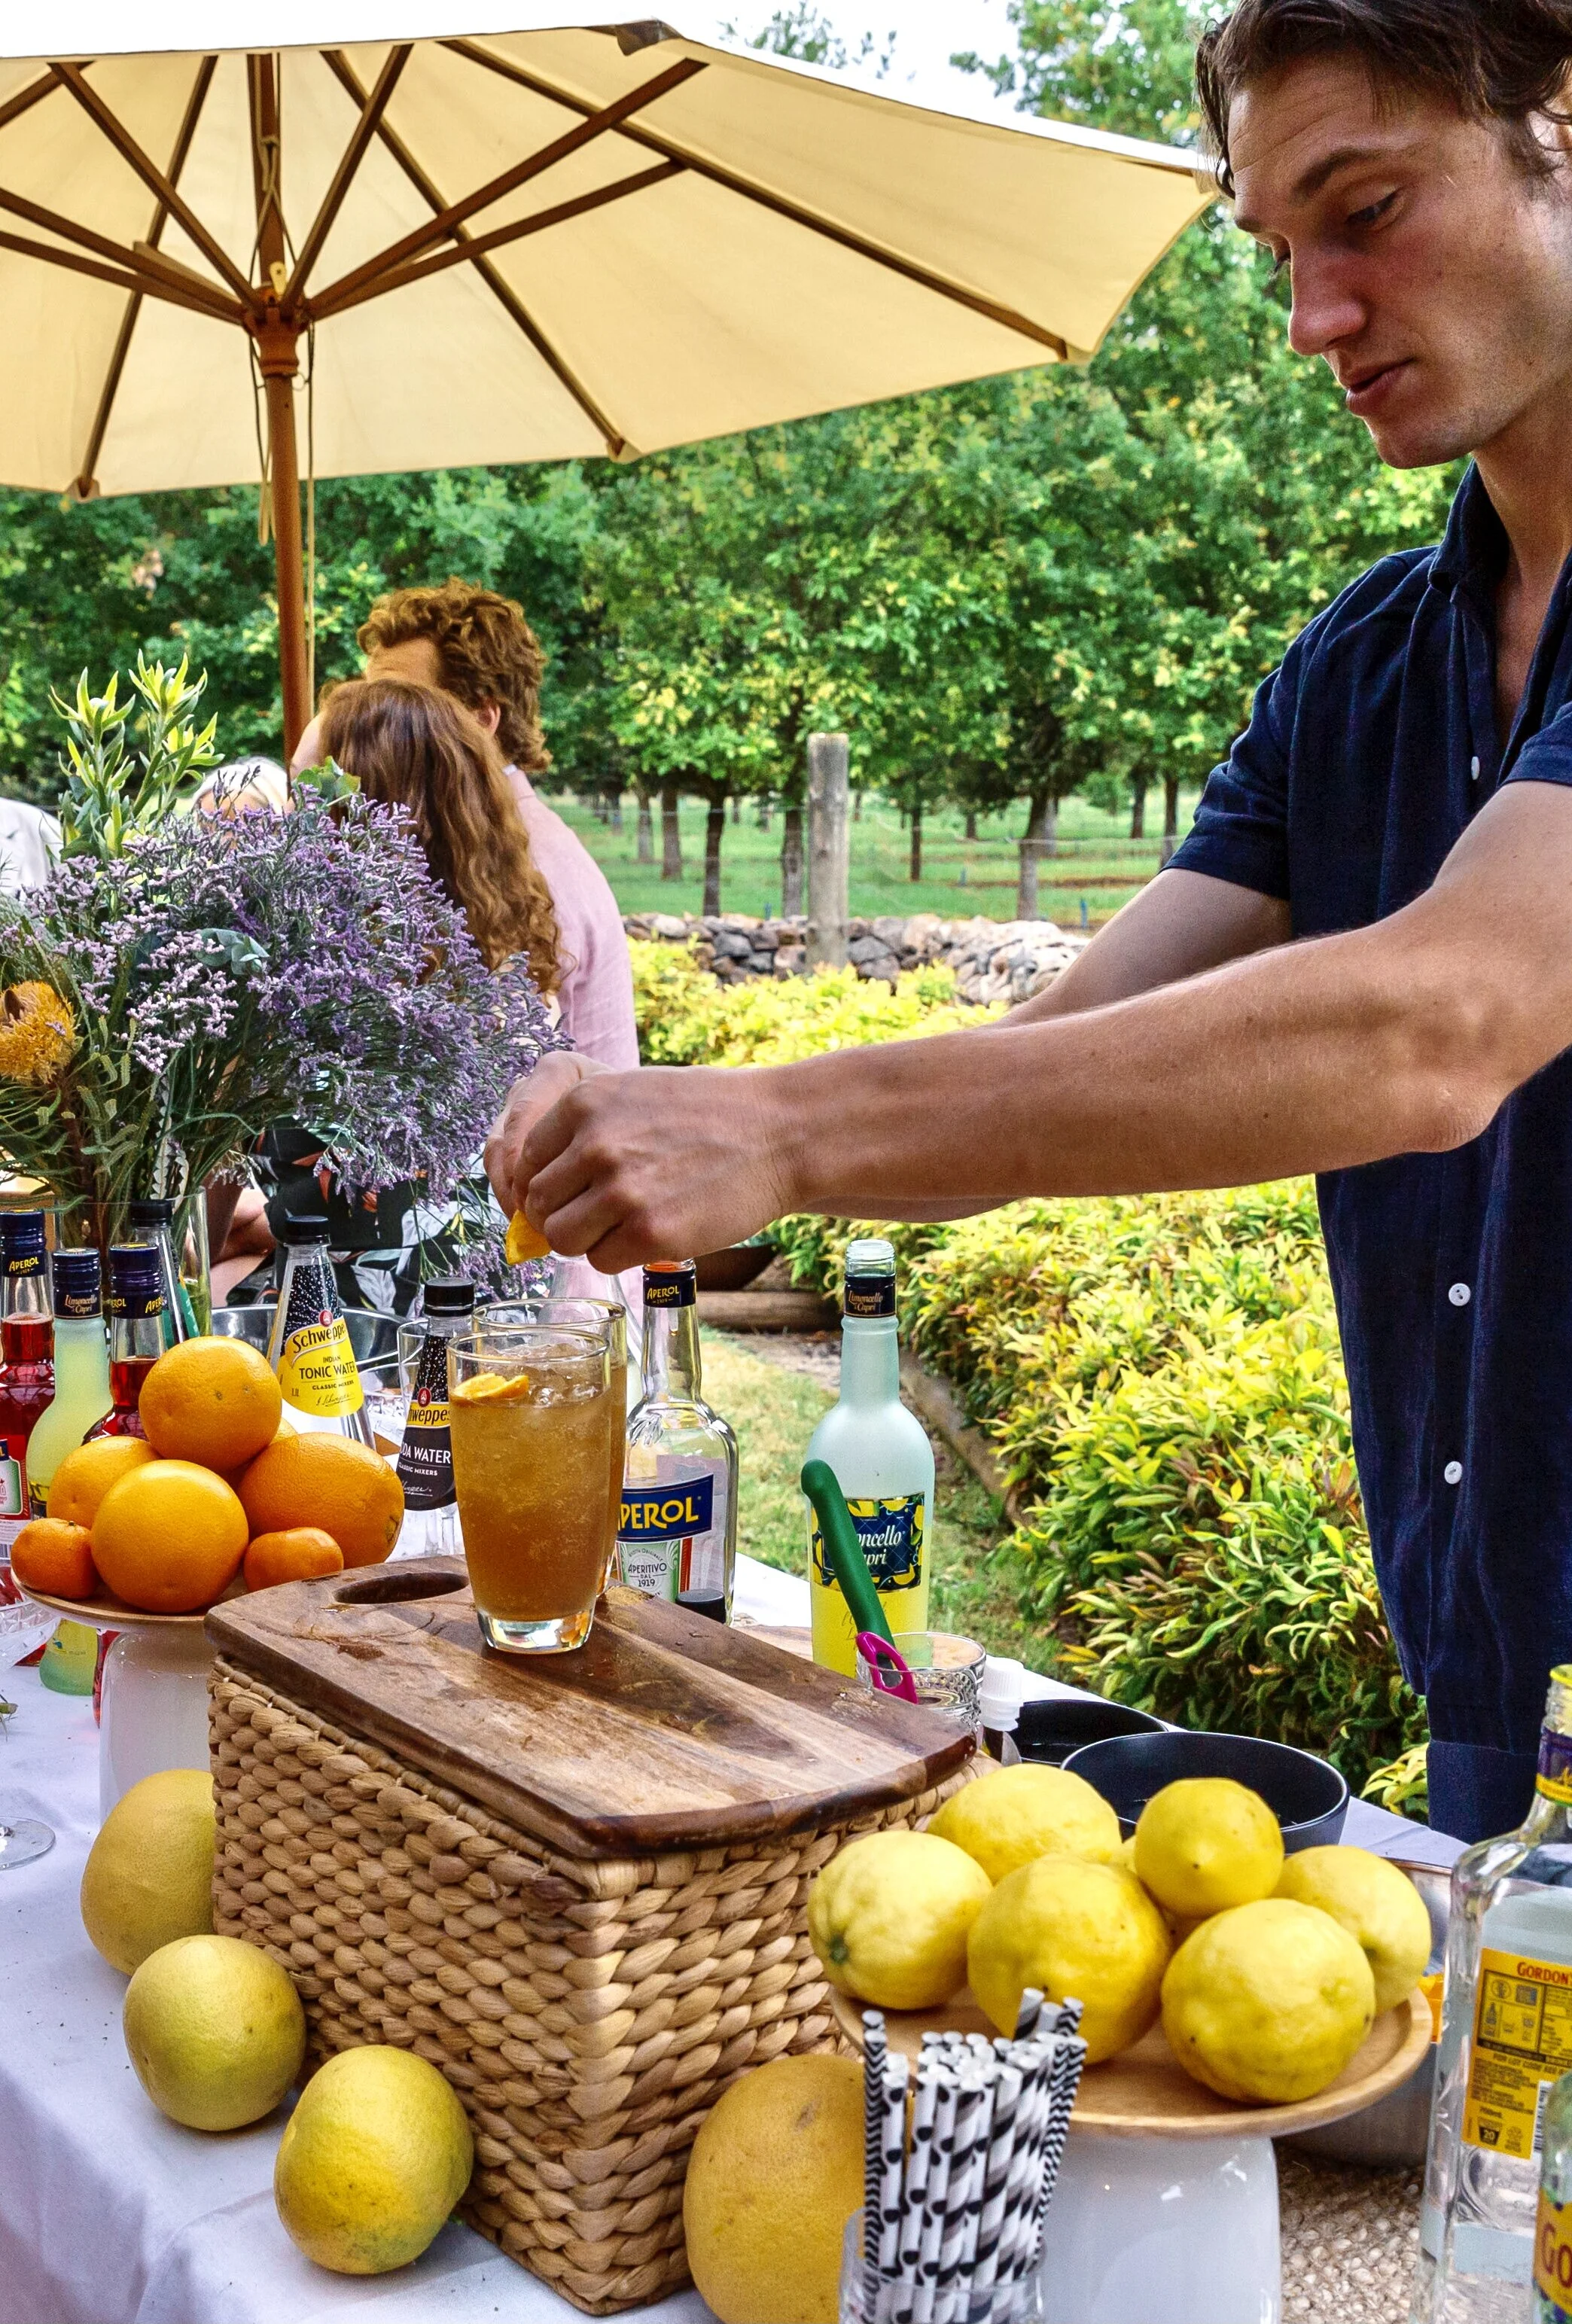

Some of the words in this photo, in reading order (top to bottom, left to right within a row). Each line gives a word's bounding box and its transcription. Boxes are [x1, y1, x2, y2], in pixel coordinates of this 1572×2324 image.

[9, 1256, 39, 1272] APEROL
[647, 1285, 680, 1299] APEROL
[299, 1365, 332, 1379] TONIC
[413, 1446, 451, 1464] WATER
[414, 1468, 438, 1476] MIXERS
[618, 1496, 699, 1531] PEROL
[628, 1562, 667, 1573] APERITIVO
[638, 1578, 656, 1587] 1919
